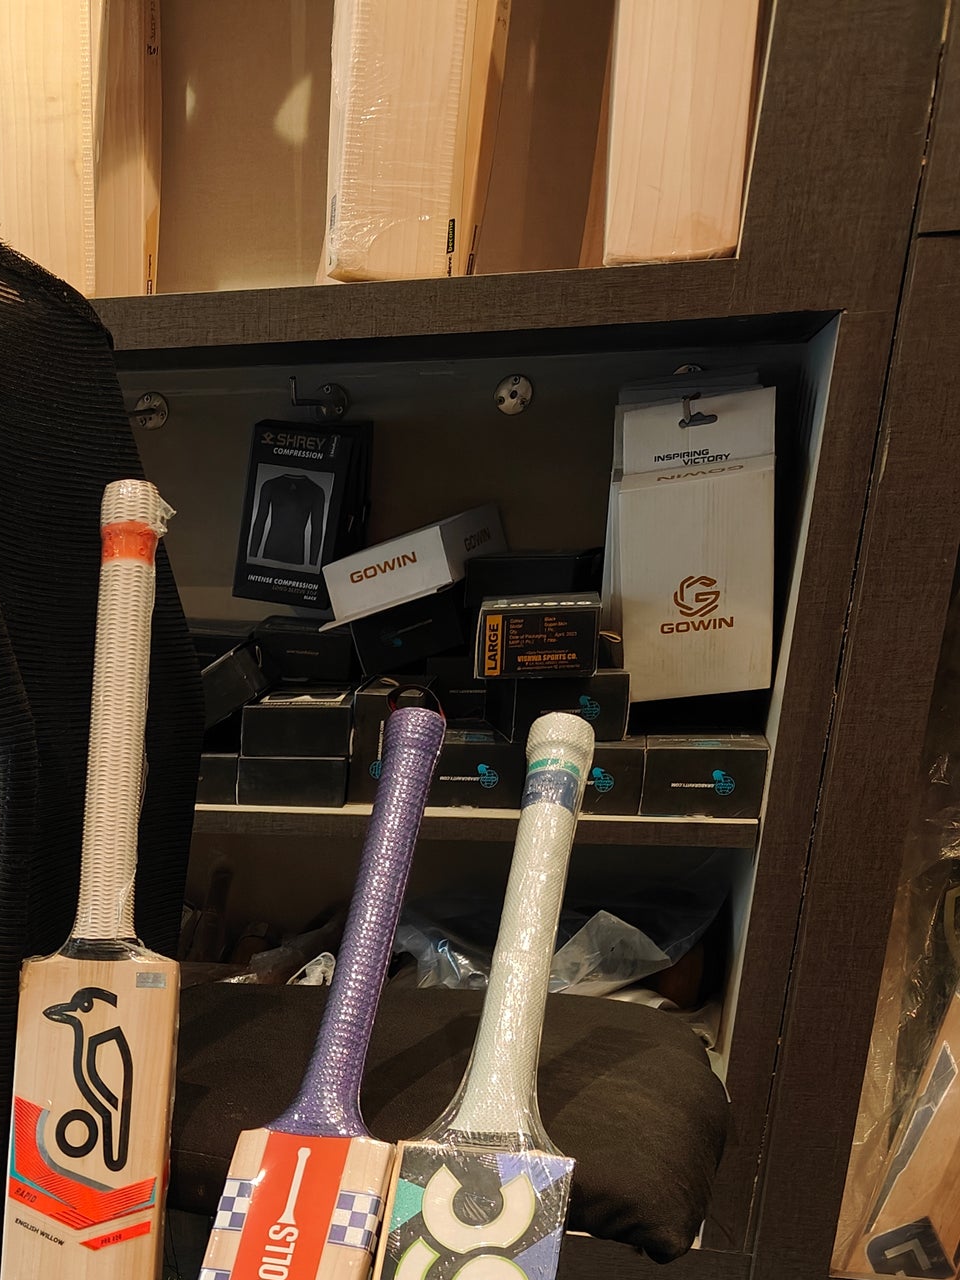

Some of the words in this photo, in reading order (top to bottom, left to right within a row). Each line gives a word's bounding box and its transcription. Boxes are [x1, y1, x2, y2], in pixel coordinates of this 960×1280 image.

[276, 433, 327, 450] SHREY
[273, 447, 324, 460] COMPRESSION
[654, 449, 710, 463] INSPIRING
[682, 453, 731, 466] VICTORY
[350, 551, 418, 584] GOWIN
[248, 574, 273, 584] INTENSE
[273, 578, 319, 590] COMPRESSION
[660, 616, 735, 635] GOWIN
[487, 623, 499, 671] LARGE
[14, 1187, 38, 1204] RAPID
[14, 1217, 40, 1235] ENGLISH
[39, 1230, 65, 1247] WILLOW
